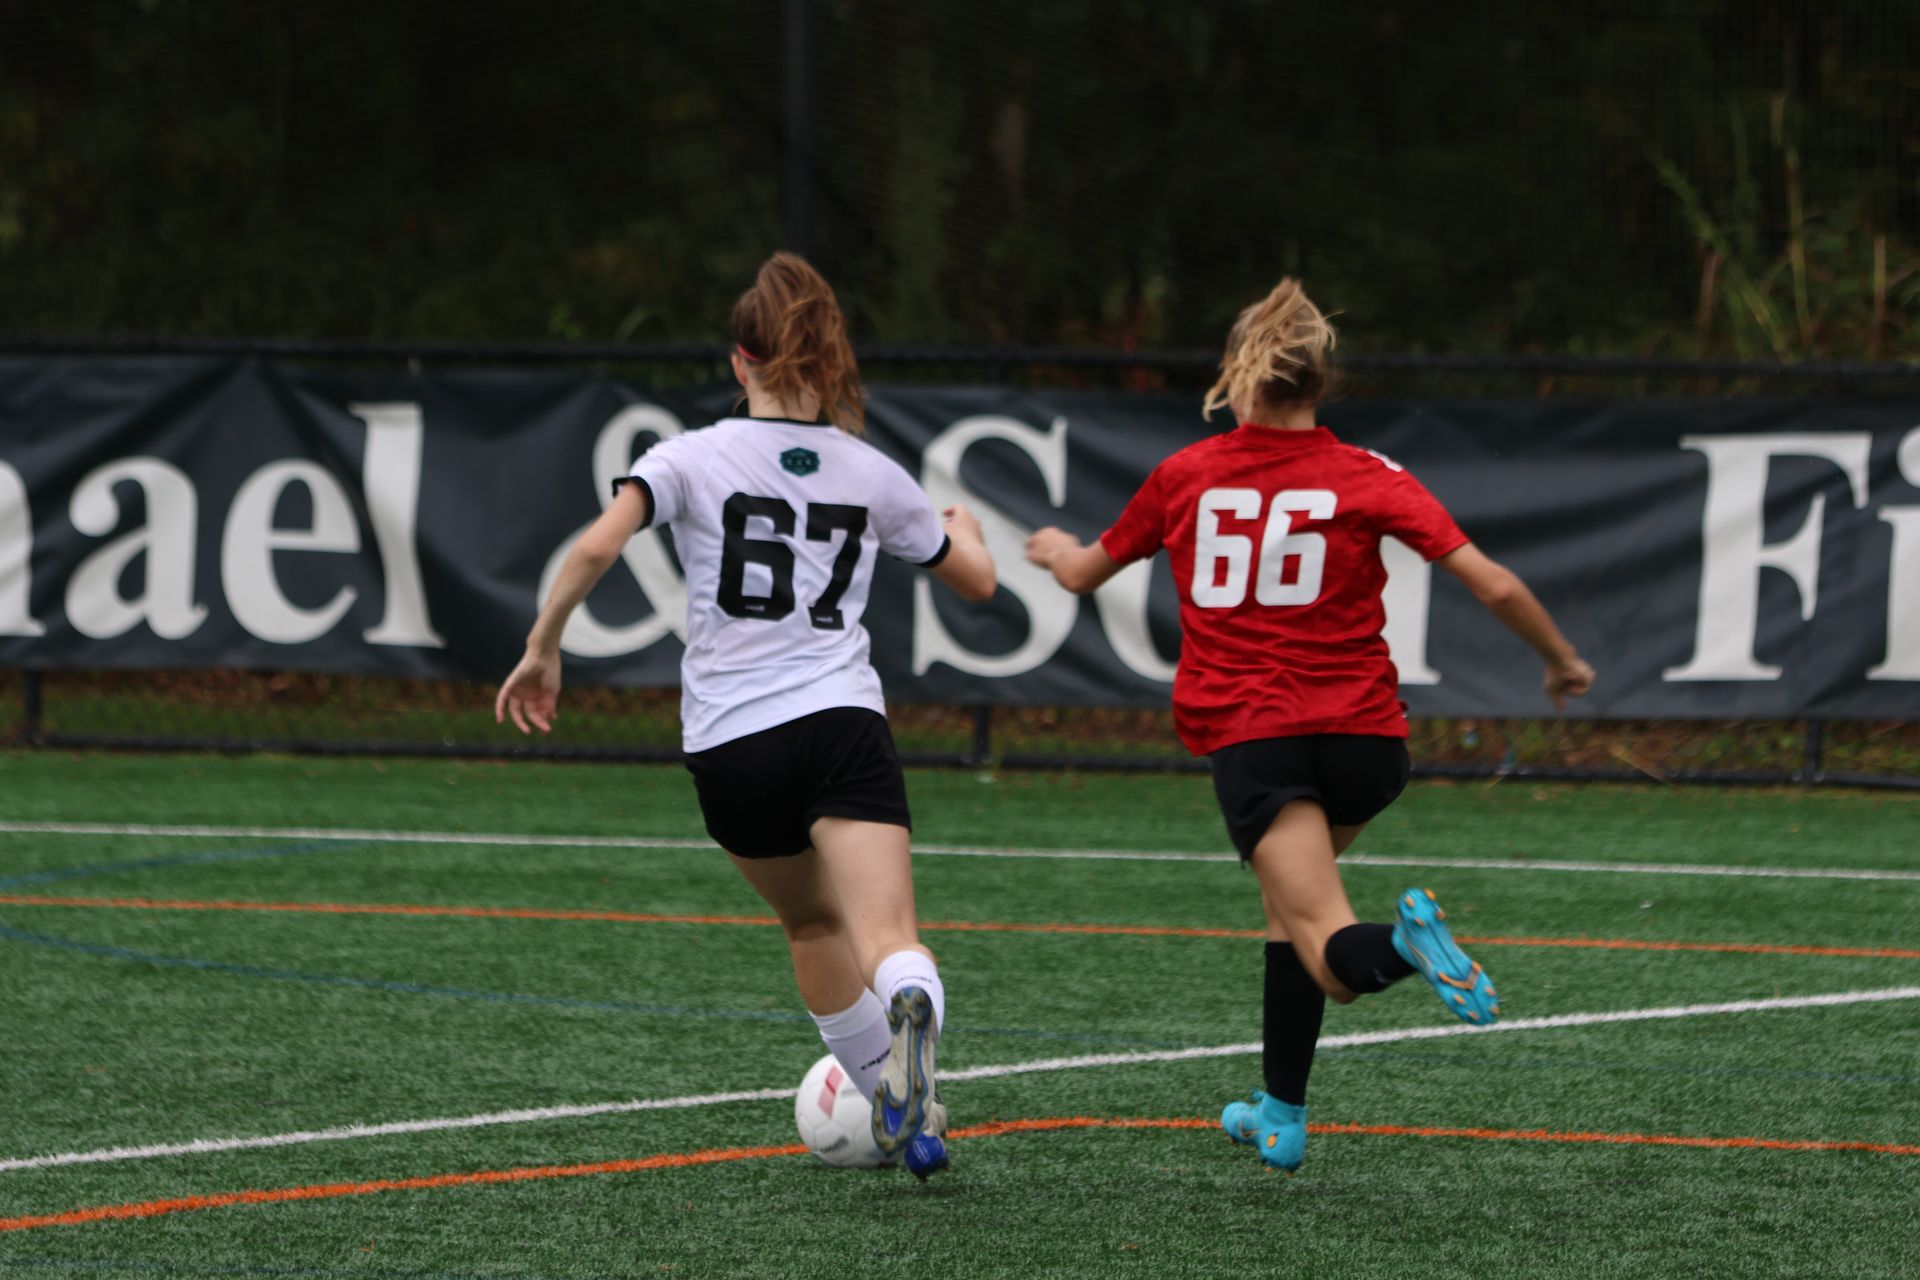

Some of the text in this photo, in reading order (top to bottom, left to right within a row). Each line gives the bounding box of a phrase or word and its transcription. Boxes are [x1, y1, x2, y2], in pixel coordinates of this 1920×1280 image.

[537, 403, 689, 658] &
[716, 491, 869, 631] 67
[1190, 486, 1338, 609] 66
